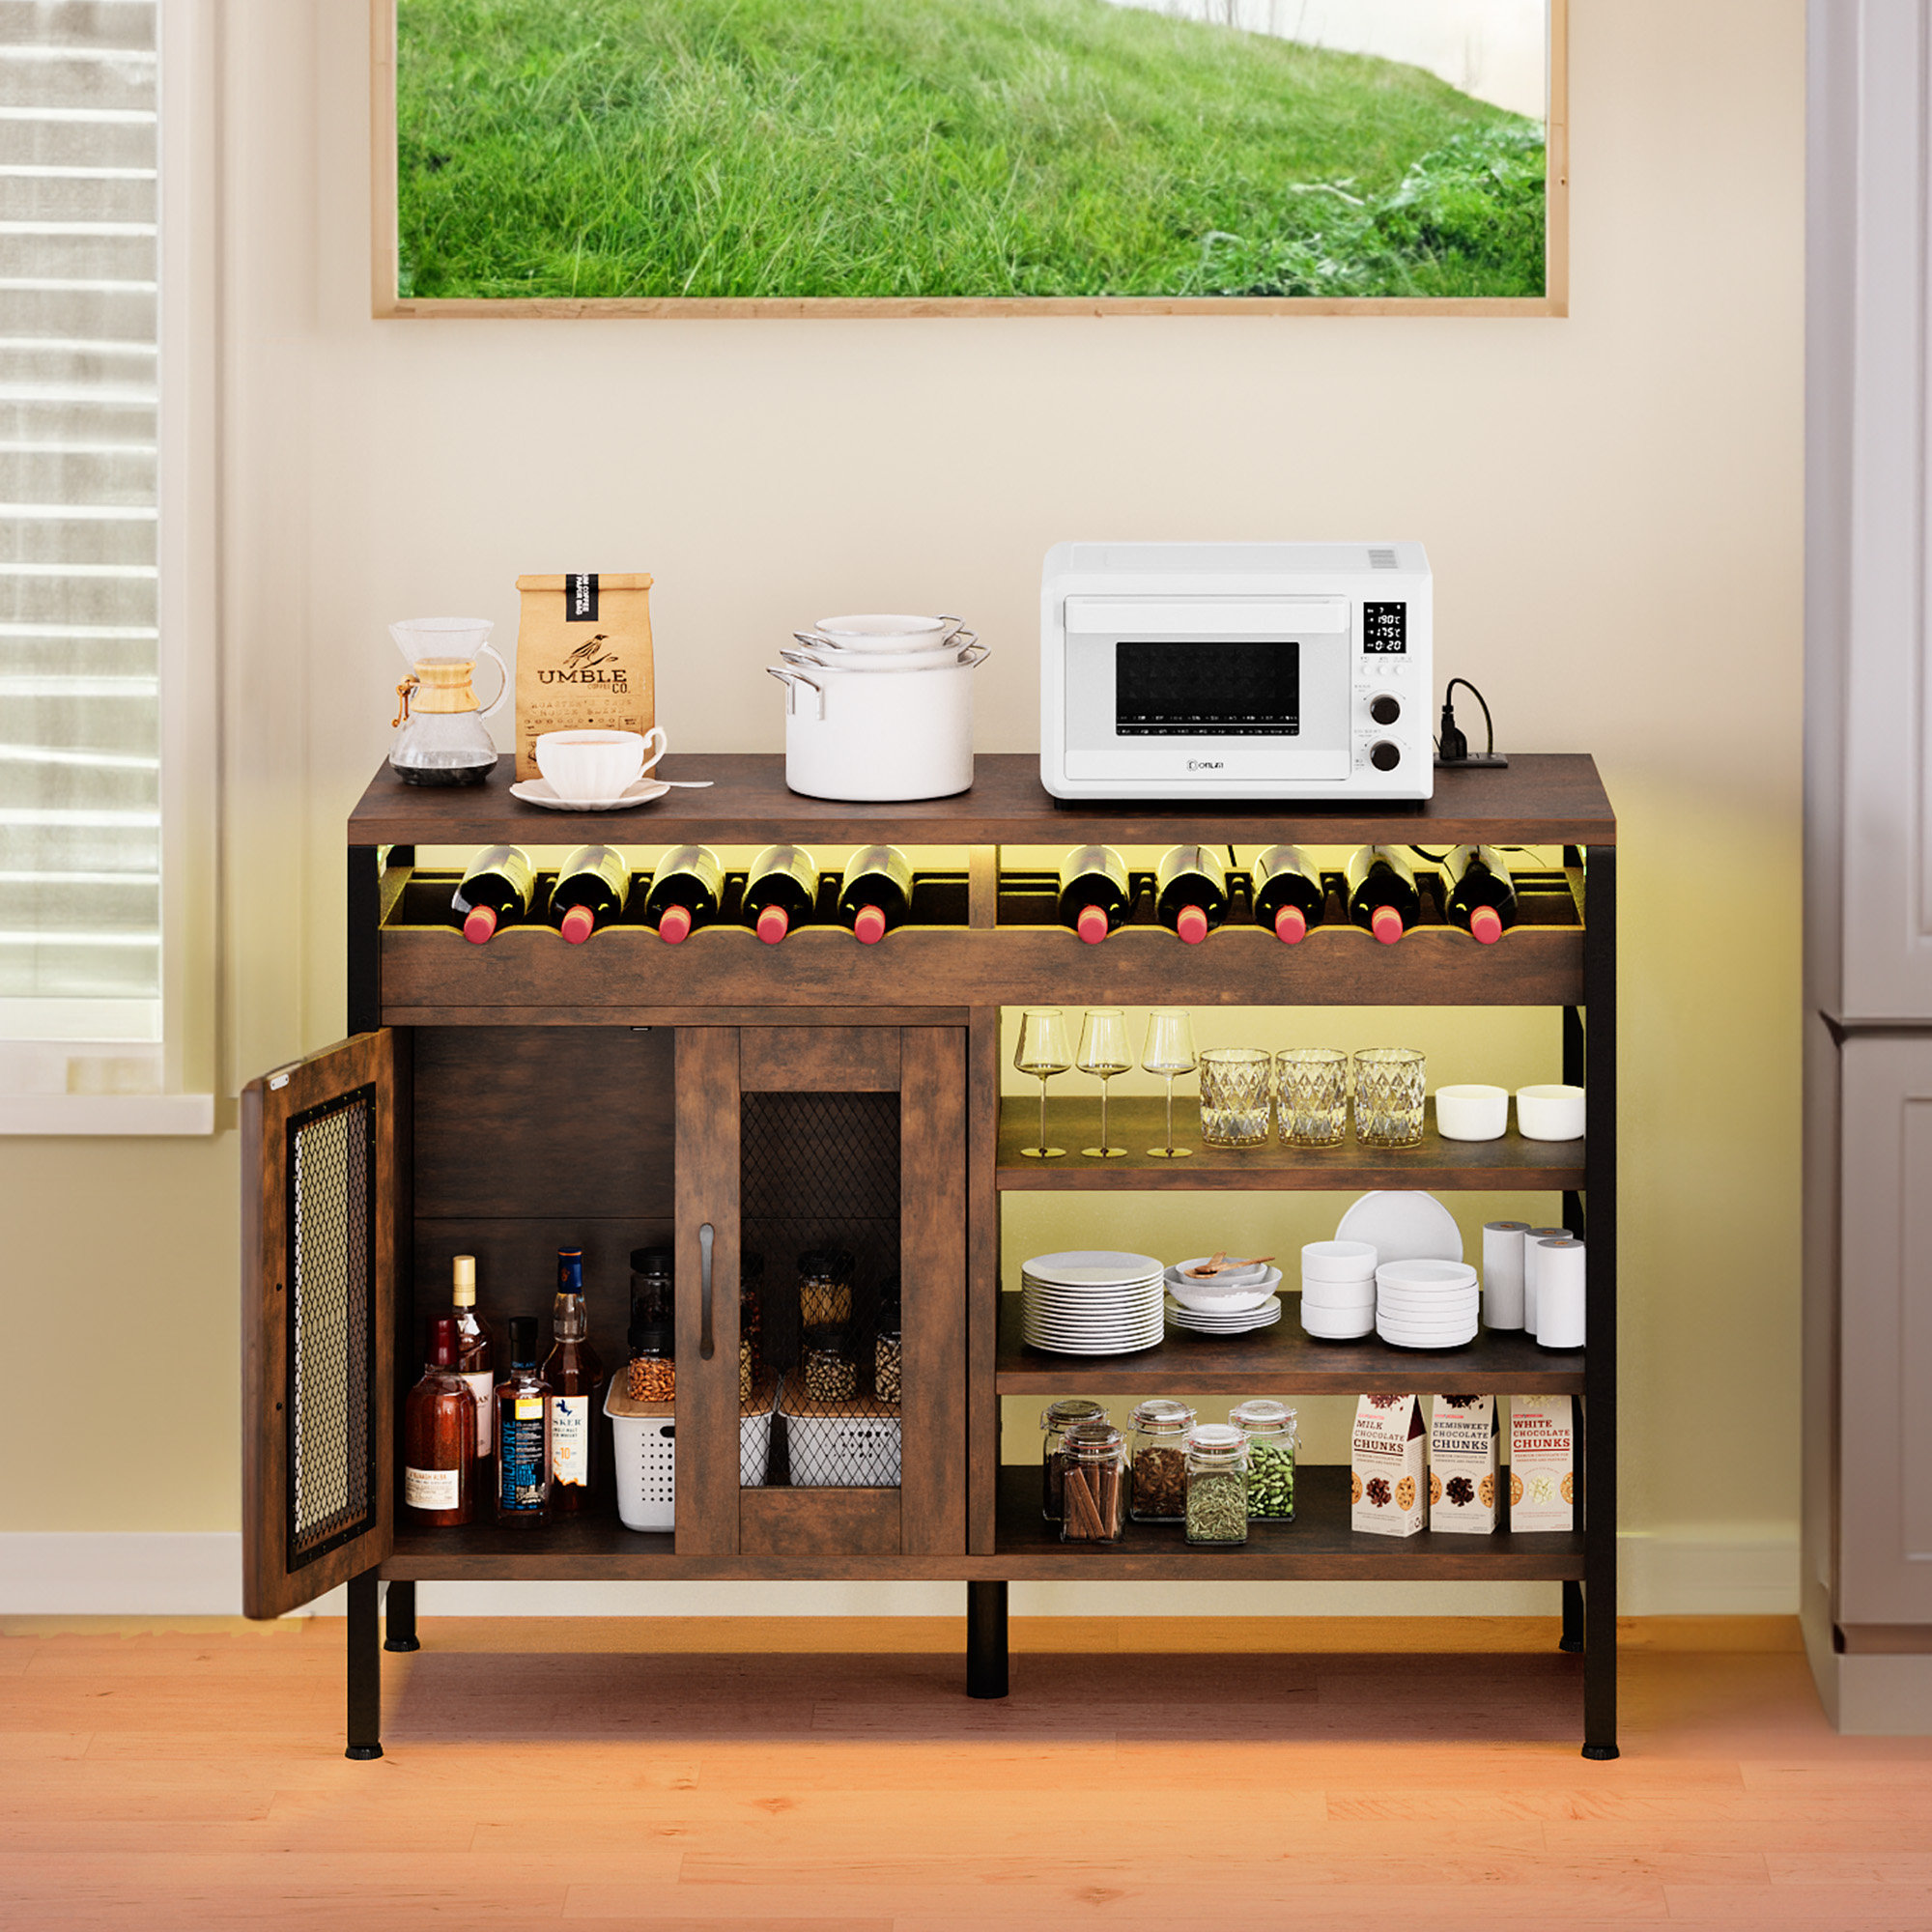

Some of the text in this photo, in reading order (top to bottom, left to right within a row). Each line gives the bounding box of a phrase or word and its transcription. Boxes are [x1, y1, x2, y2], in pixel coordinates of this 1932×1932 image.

[537, 669, 627, 685] UMBLE
[1356, 1420, 1383, 1430] MILK
[1513, 1419, 1552, 1429] WHITE
[502, 1421, 516, 1444] RYE
[1354, 1430, 1405, 1441] CHOCOLATE
[1433, 1430, 1489, 1439] CHOCOLATE
[1513, 1429, 1570, 1437] CHOCOLATE
[1353, 1438, 1404, 1453] CHUNKS
[1433, 1439, 1489, 1450] CHUNKS
[1513, 1437, 1571, 1449] CHUNKS
[560, 1447, 571, 1460] 10
